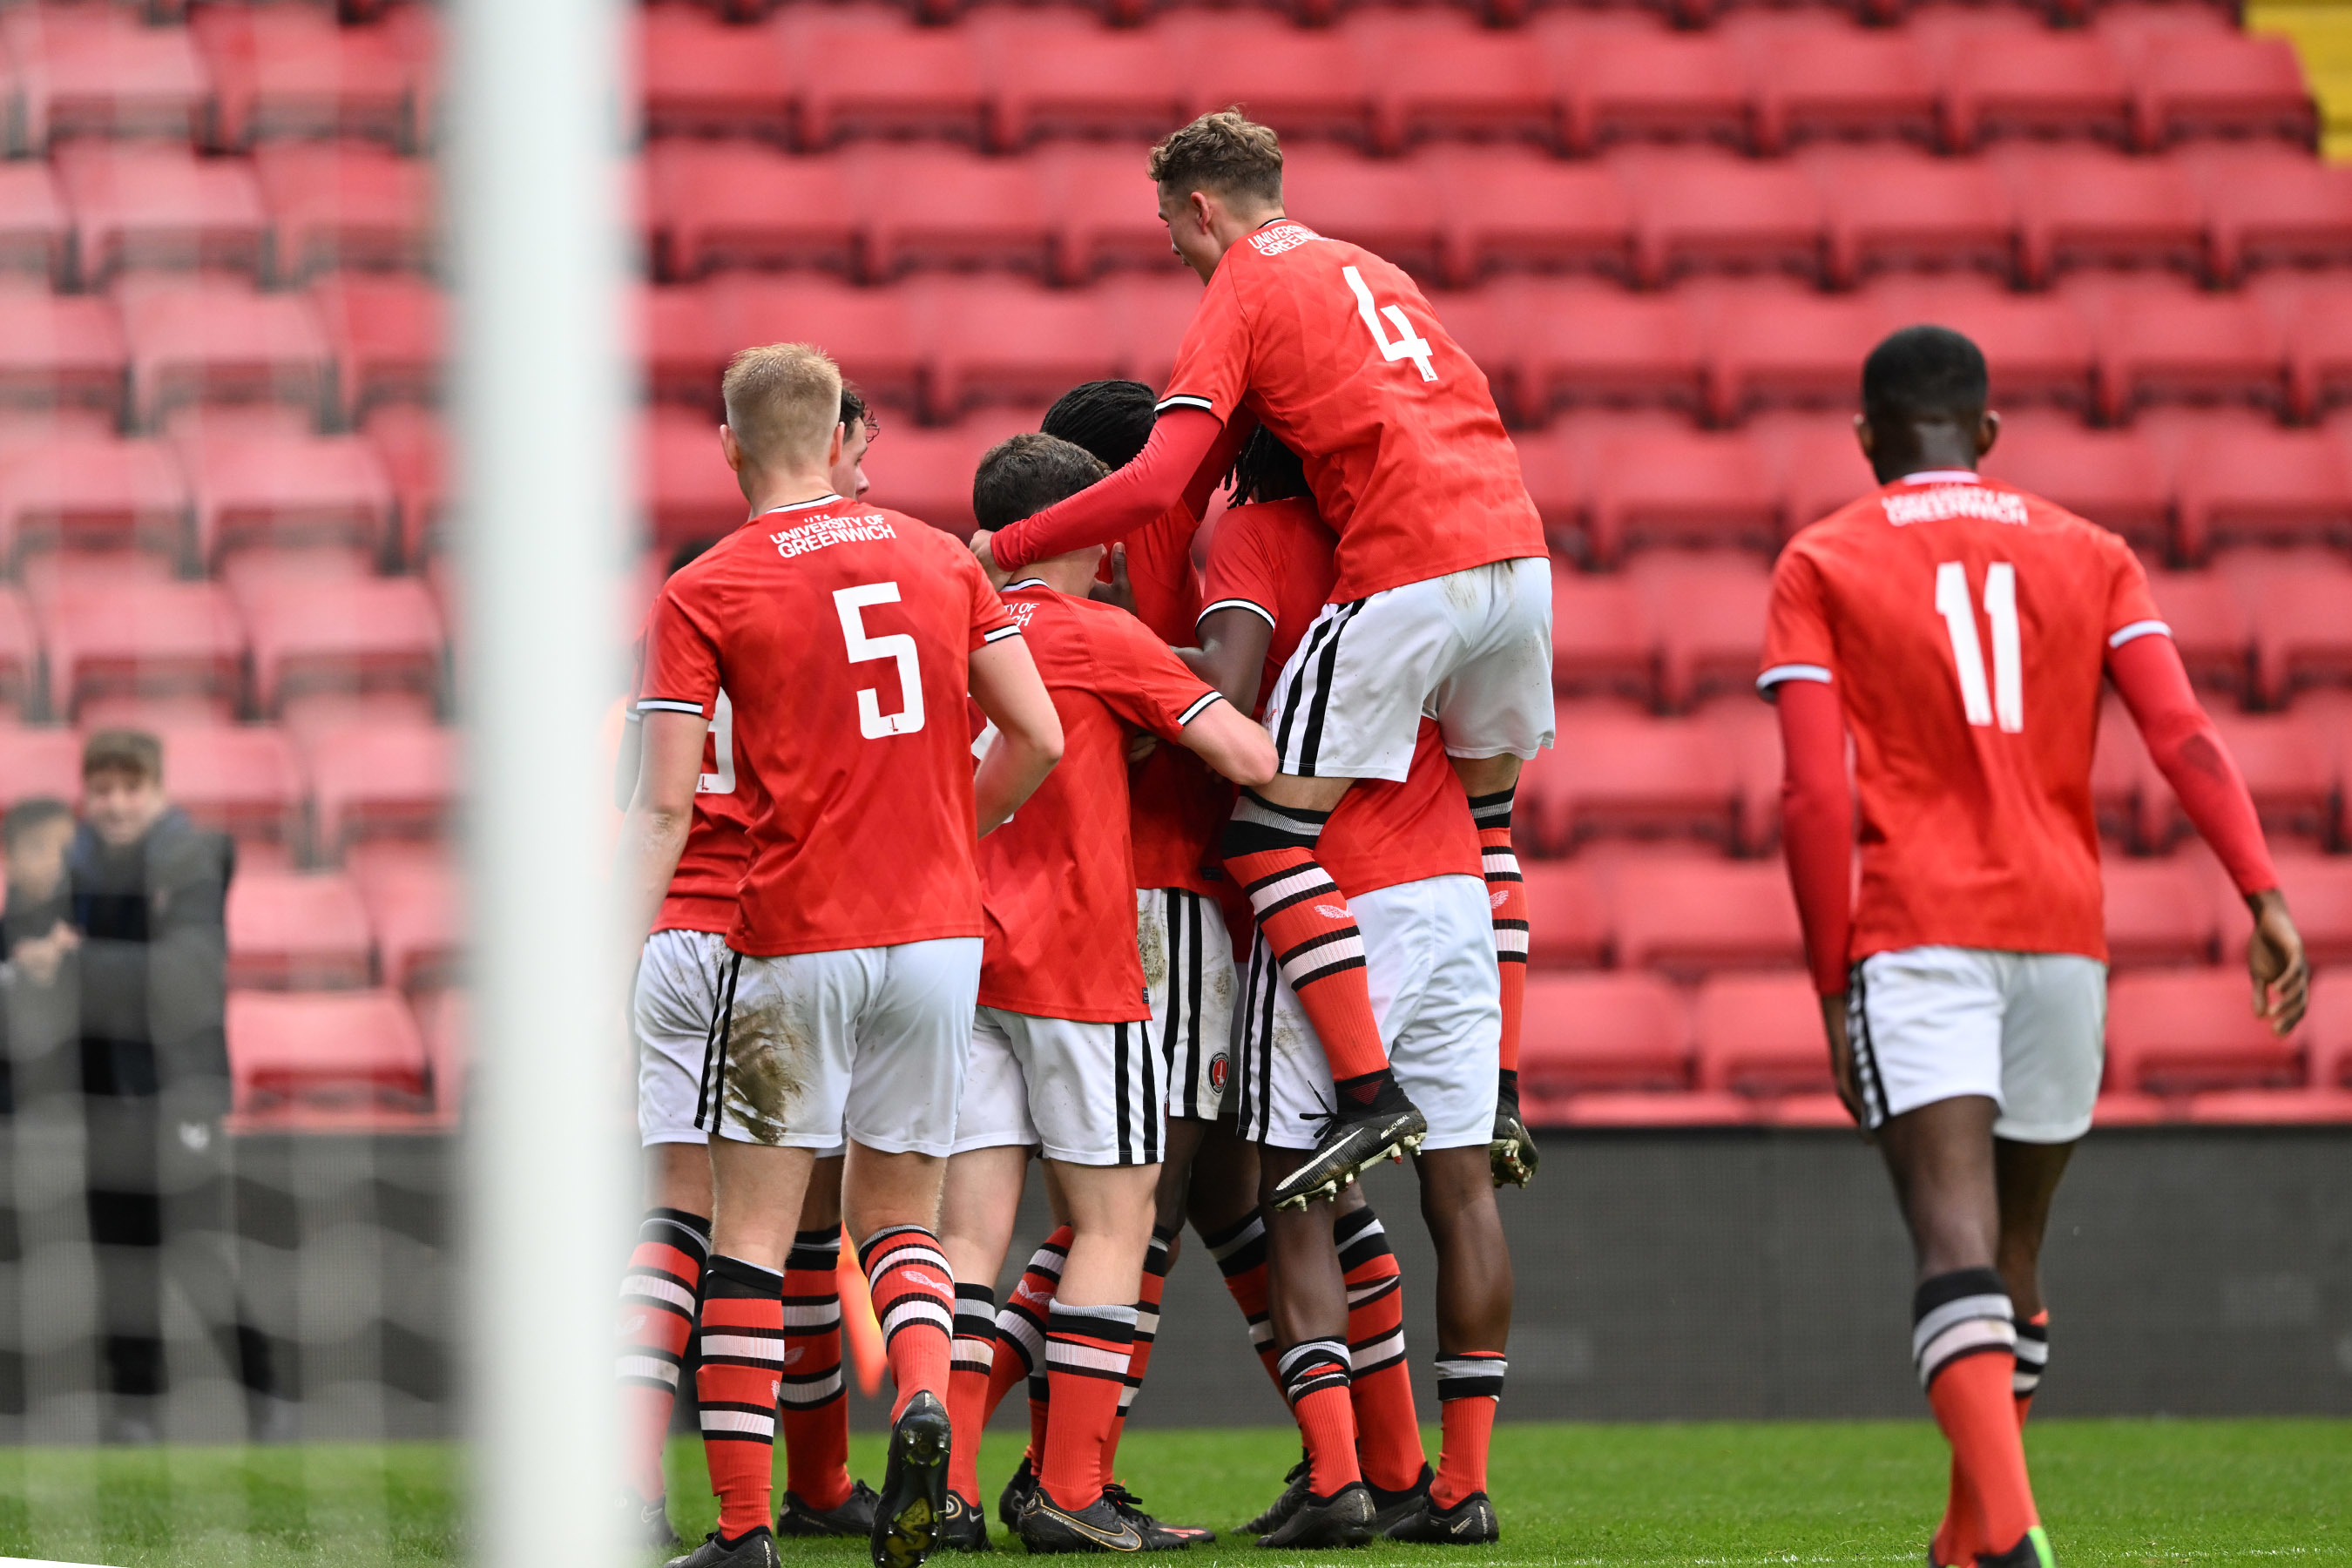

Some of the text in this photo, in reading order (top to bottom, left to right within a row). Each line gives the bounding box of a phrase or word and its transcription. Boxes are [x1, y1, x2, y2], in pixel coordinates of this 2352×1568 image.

[1342, 266, 1438, 382] 4
[769, 514, 885, 544] UNIVERSITY OF
[778, 524, 897, 558] GREENWICH
[1018, 603, 1040, 614] OF
[832, 581, 925, 740] 5
[1935, 561, 2024, 733] 11
